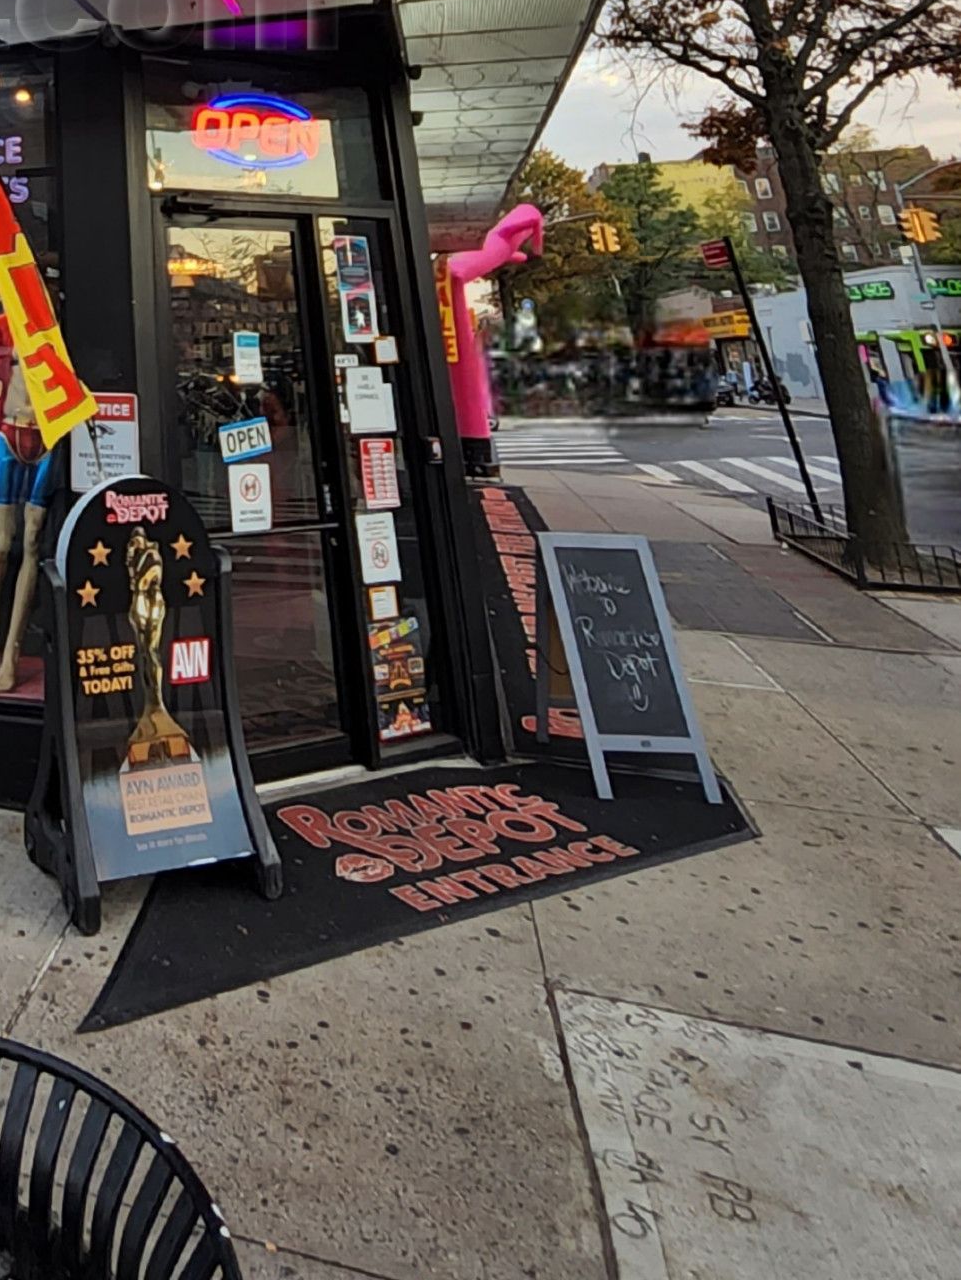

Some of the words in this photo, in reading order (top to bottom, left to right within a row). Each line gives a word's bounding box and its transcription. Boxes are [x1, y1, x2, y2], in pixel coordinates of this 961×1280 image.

[191, 106, 320, 160] OPEN
[99, 403, 130, 417] TICE
[226, 426, 267, 453] OPEN
[105, 490, 168, 509] ROMANTIC
[116, 504, 169, 524] DEPOT
[77, 646, 107, 665] 35%
[110, 644, 136, 661] OFF
[170, 638, 210, 680] AVN
[82, 675, 133, 695] TODAY!
[126, 779, 154, 797] AVN
[157, 771, 200, 791] AWARD
[129, 809, 176, 824] ROMANTIC
[276, 783, 543, 849] ROMANTIC
[372, 800, 588, 873] DEPOT
[388, 834, 641, 913] ENTRANCE
